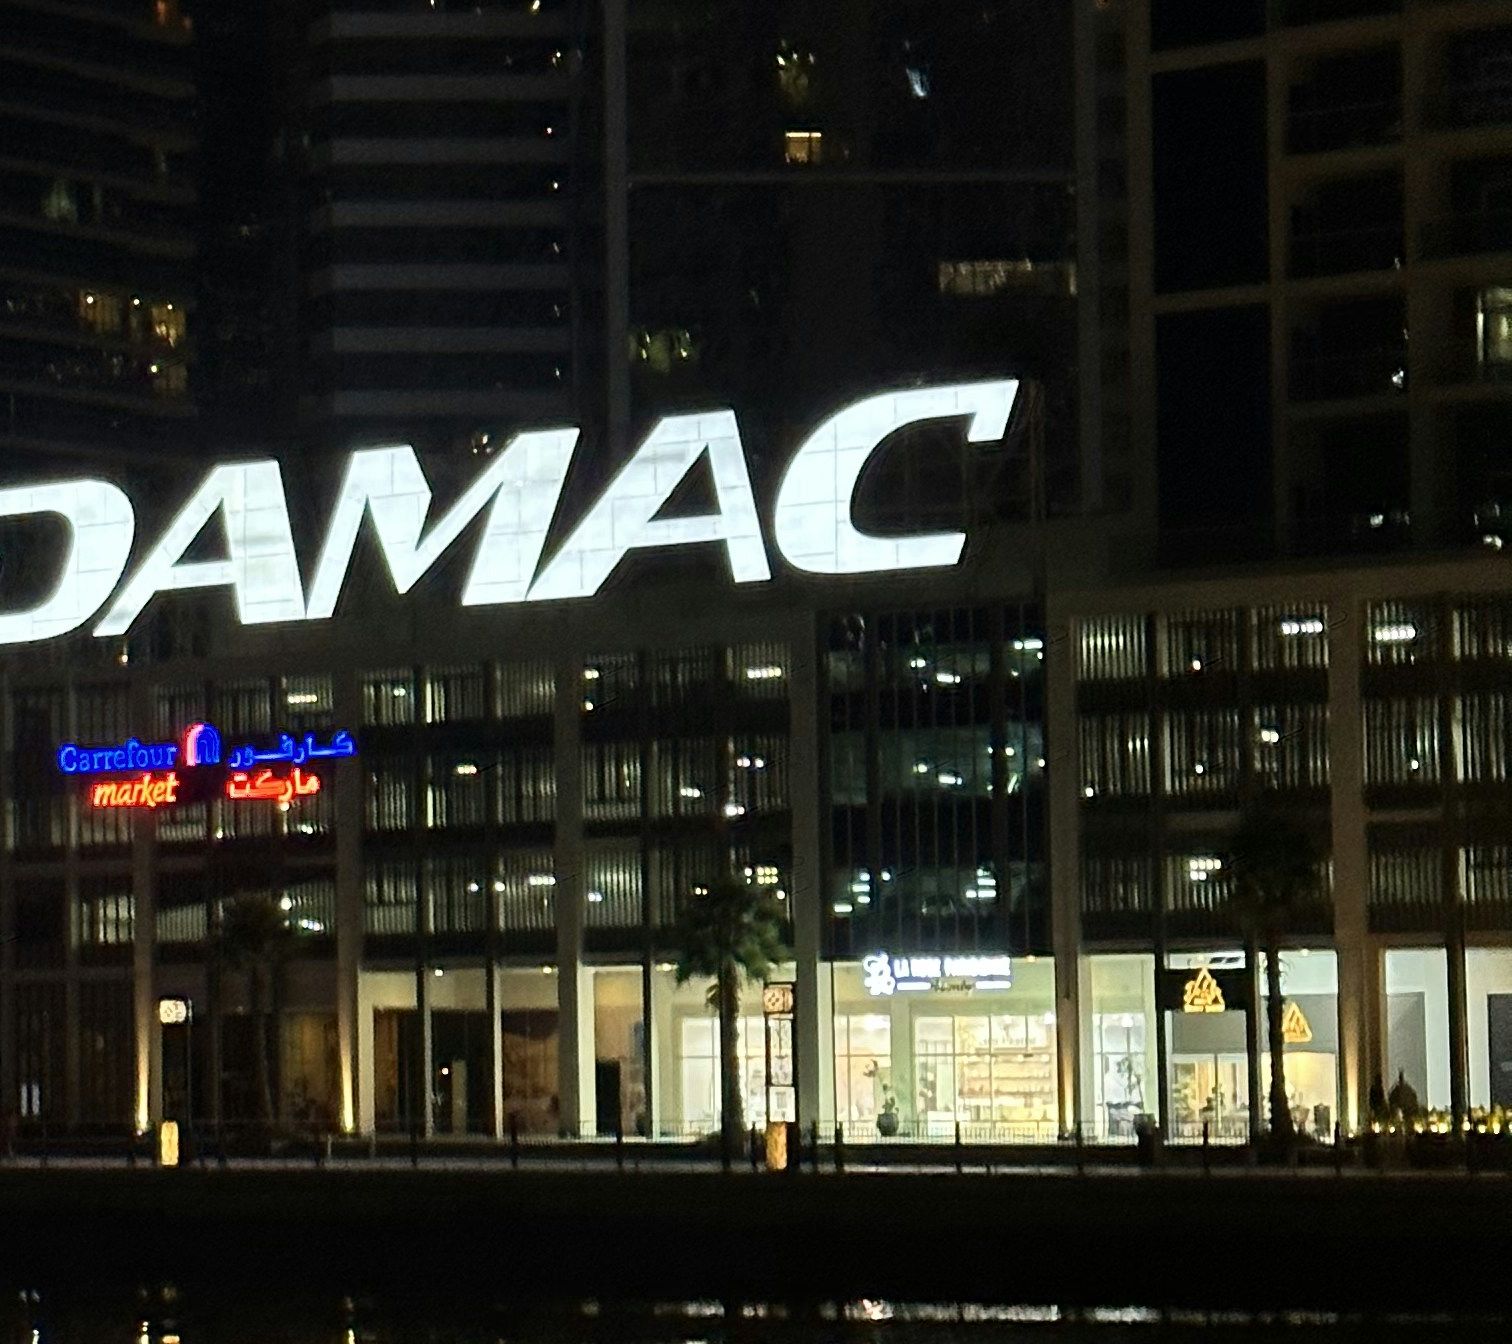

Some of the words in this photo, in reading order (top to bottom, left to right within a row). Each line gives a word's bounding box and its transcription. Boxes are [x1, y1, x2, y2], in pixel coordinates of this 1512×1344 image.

[60, 739, 178, 772] Carrefour
[230, 732, 354, 768] كارفور
[92, 772, 179, 807] market
[227, 767, 320, 800] ماركت
